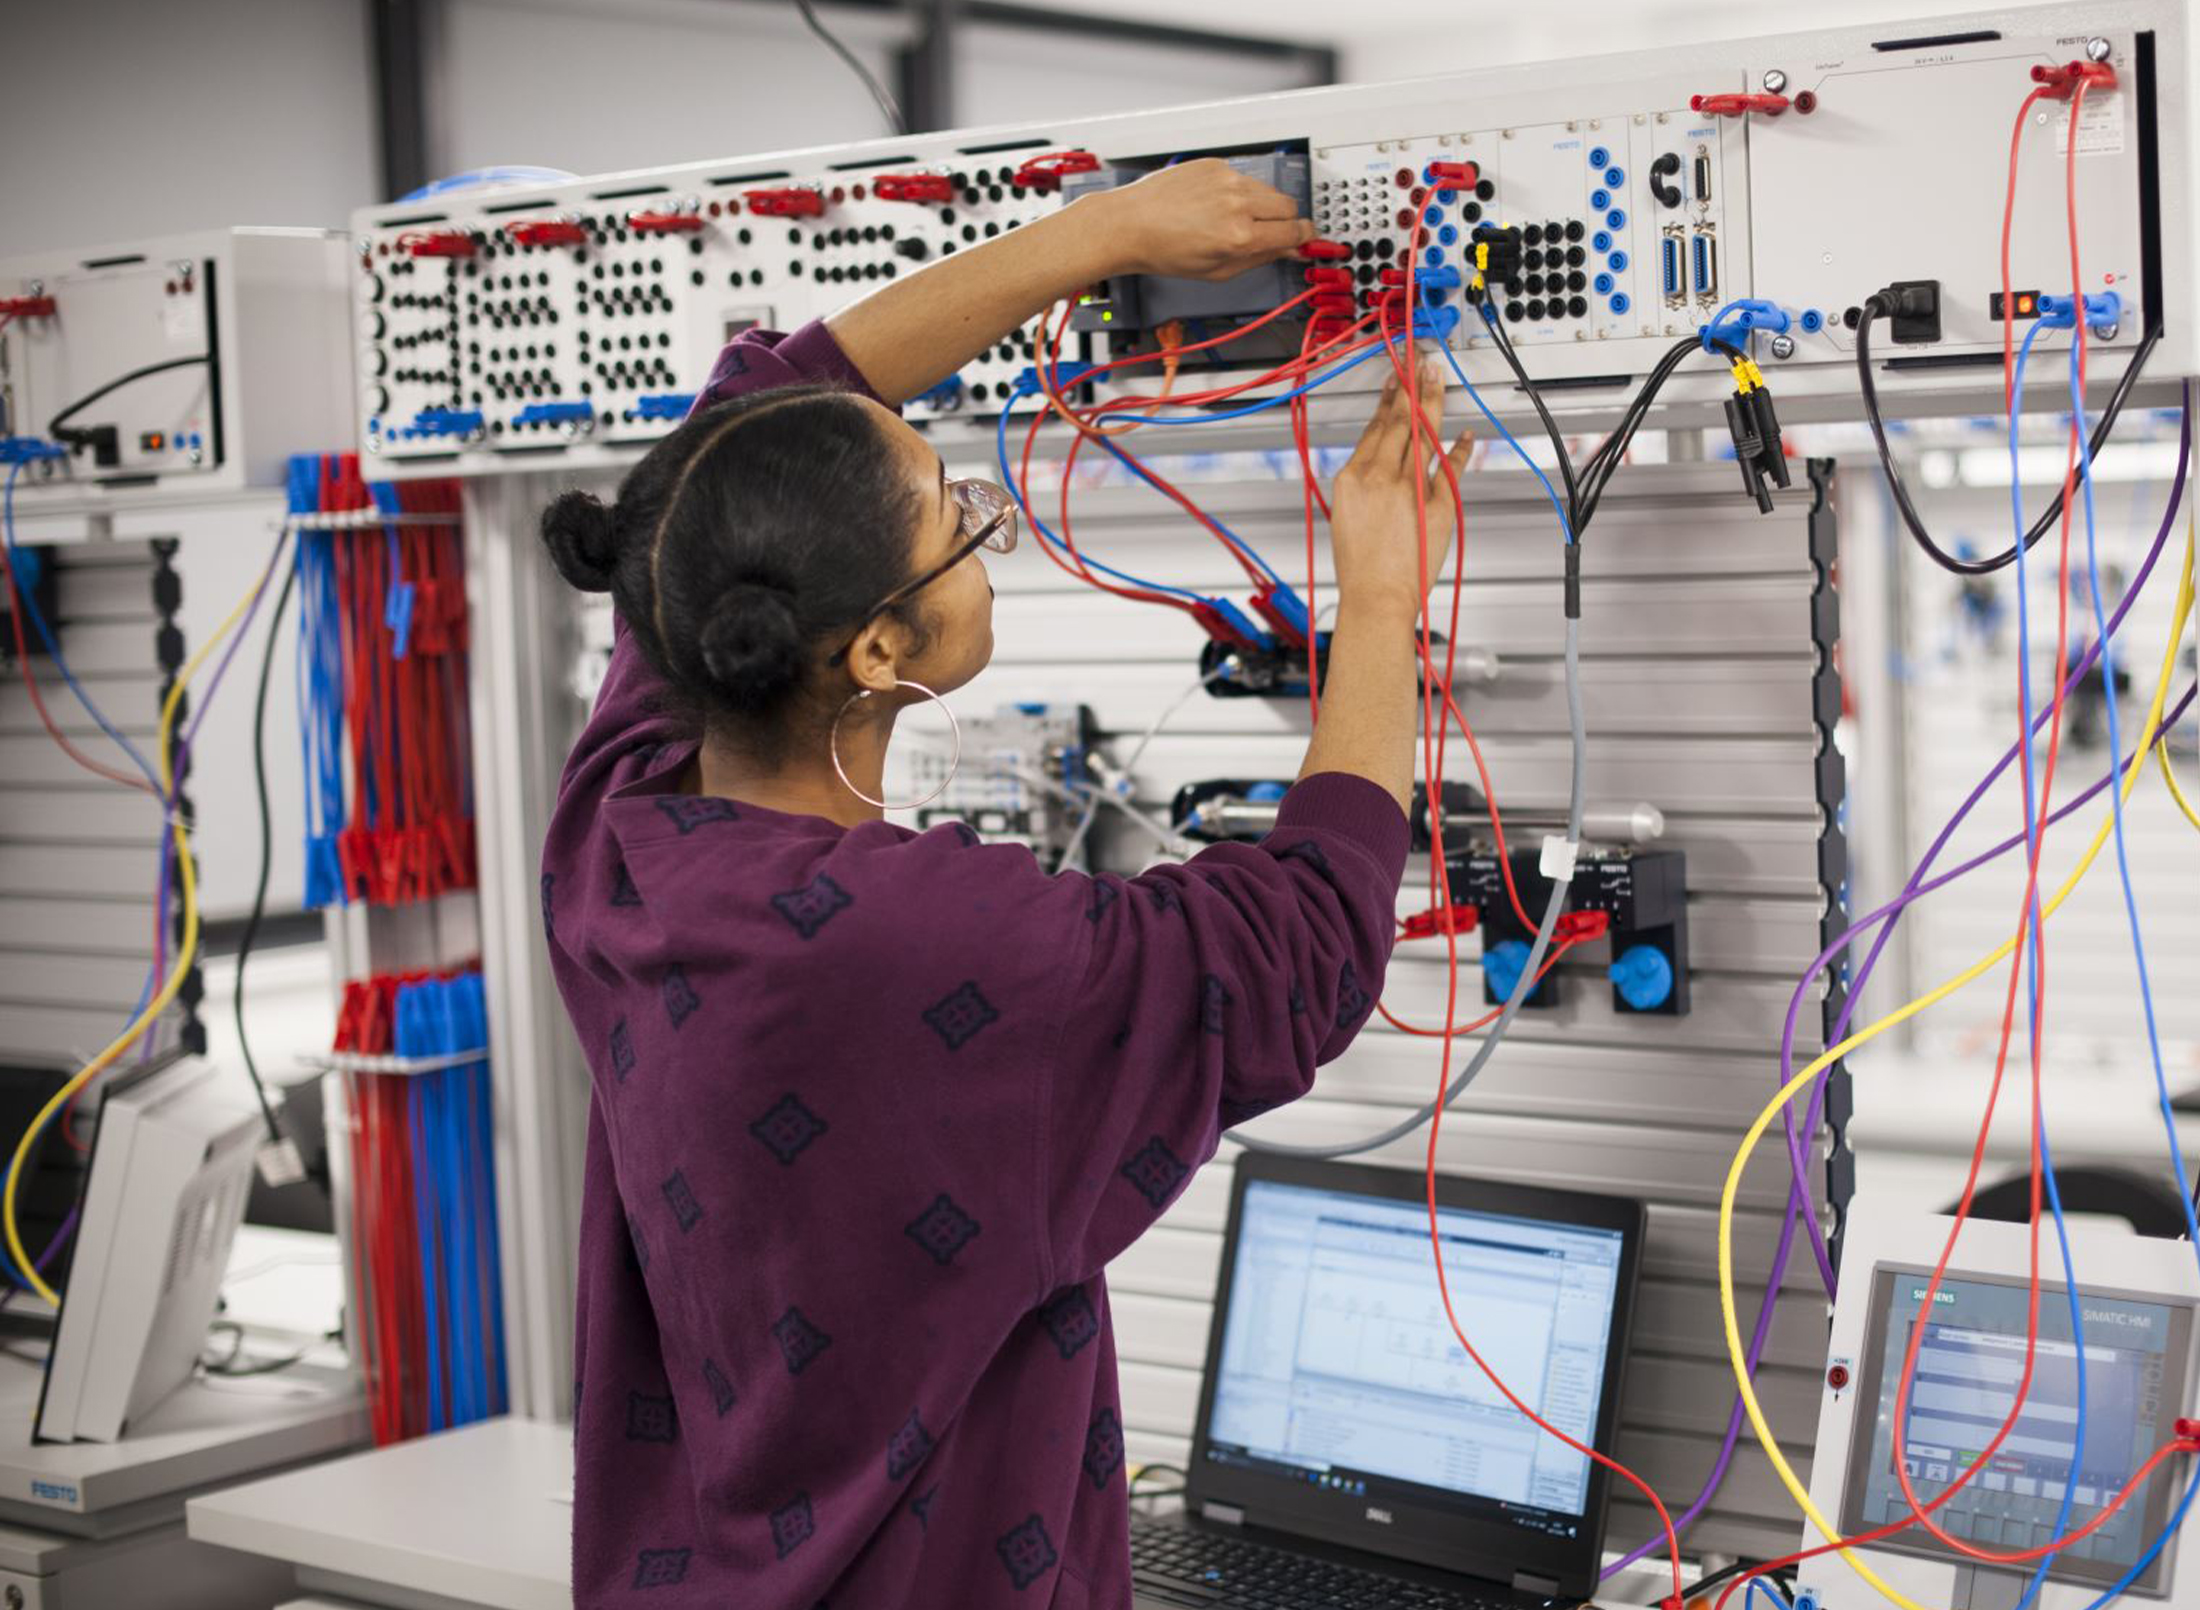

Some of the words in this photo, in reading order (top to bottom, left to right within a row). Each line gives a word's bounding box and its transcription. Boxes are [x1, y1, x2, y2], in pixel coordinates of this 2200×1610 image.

[2056, 36, 2088, 46] FESTO
[1687, 128, 1716, 138] FESTO
[1600, 864, 1628, 874] FESTO
[1913, 1288, 1955, 1304] SIEENS
[2083, 1309, 2127, 1326] SIMATIC
[31, 1480, 77, 1502] FESTO
[1366, 1508, 1391, 1524] DELL
